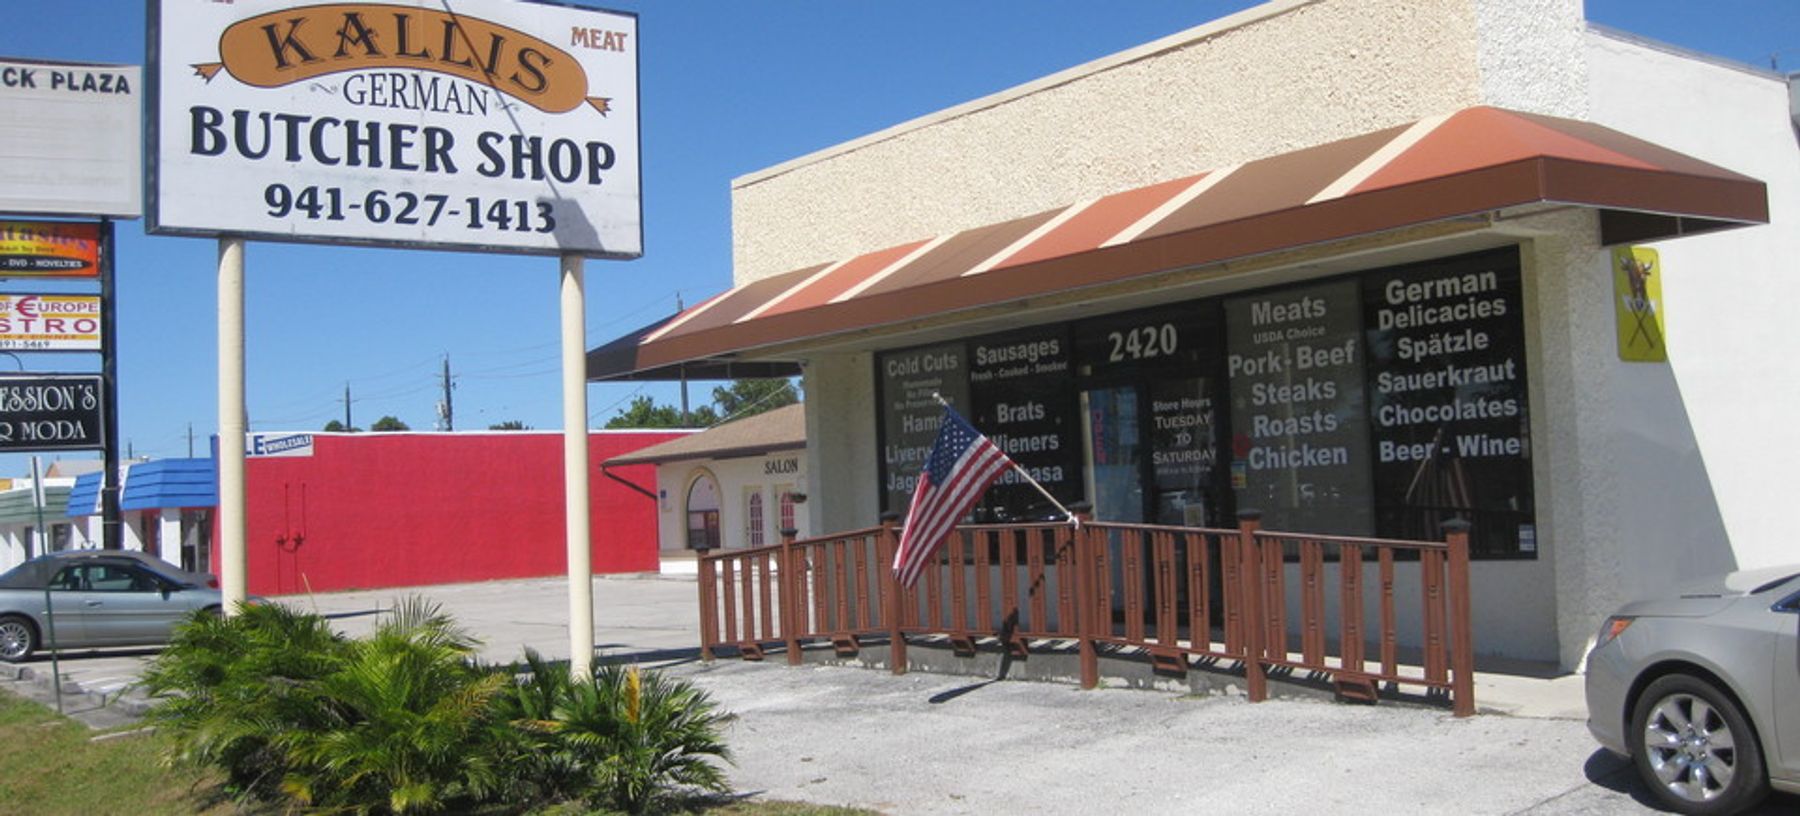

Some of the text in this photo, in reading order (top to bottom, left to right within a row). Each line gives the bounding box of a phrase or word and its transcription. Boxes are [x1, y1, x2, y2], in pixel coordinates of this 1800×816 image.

[261, 11, 553, 95] KALLIS
[570, 26, 628, 52] MEAT
[2, 67, 130, 94] CK PLAZA
[343, 73, 489, 116] GERMAN
[189, 105, 616, 186] BUTCHER SHOP
[264, 183, 557, 234] 941-627-1413
[9, 258, 28, 268] DVD
[36, 259, 83, 268] NOVELTIES
[1386, 271, 1497, 305] German
[1252, 297, 1326, 326] Meats
[1378, 298, 1507, 331] Delicacies
[1108, 323, 1178, 363] 2420
[1253, 325, 1325, 344] USDA Choice
[1397, 329, 1489, 362] Spätzle
[888, 353, 958, 377] Cold Cuts
[976, 339, 1060, 366] Sausages
[1228, 350, 1282, 377] Pork
[1297, 340, 1356, 371] Beef
[1377, 358, 1516, 393] Sauerkraut
[0, 385, 97, 412] ESSION'S
[1153, 398, 1211, 412] Store Hours
[1252, 378, 1337, 406] Steaks
[997, 401, 1045, 423] Brats
[1154, 413, 1210, 429] TUESDAY
[1254, 410, 1338, 439] Roasts
[1379, 398, 1518, 427] Chocolates
[20, 420, 87, 441] MODA
[1175, 432, 1192, 446] TO
[1152, 449, 1217, 465] SATURDAY
[1249, 442, 1347, 470] Chicken
[1379, 440, 1435, 463] Beer
[1456, 434, 1520, 457] Wine
[765, 458, 798, 475] SALON
[993, 464, 1063, 485] elbasa
